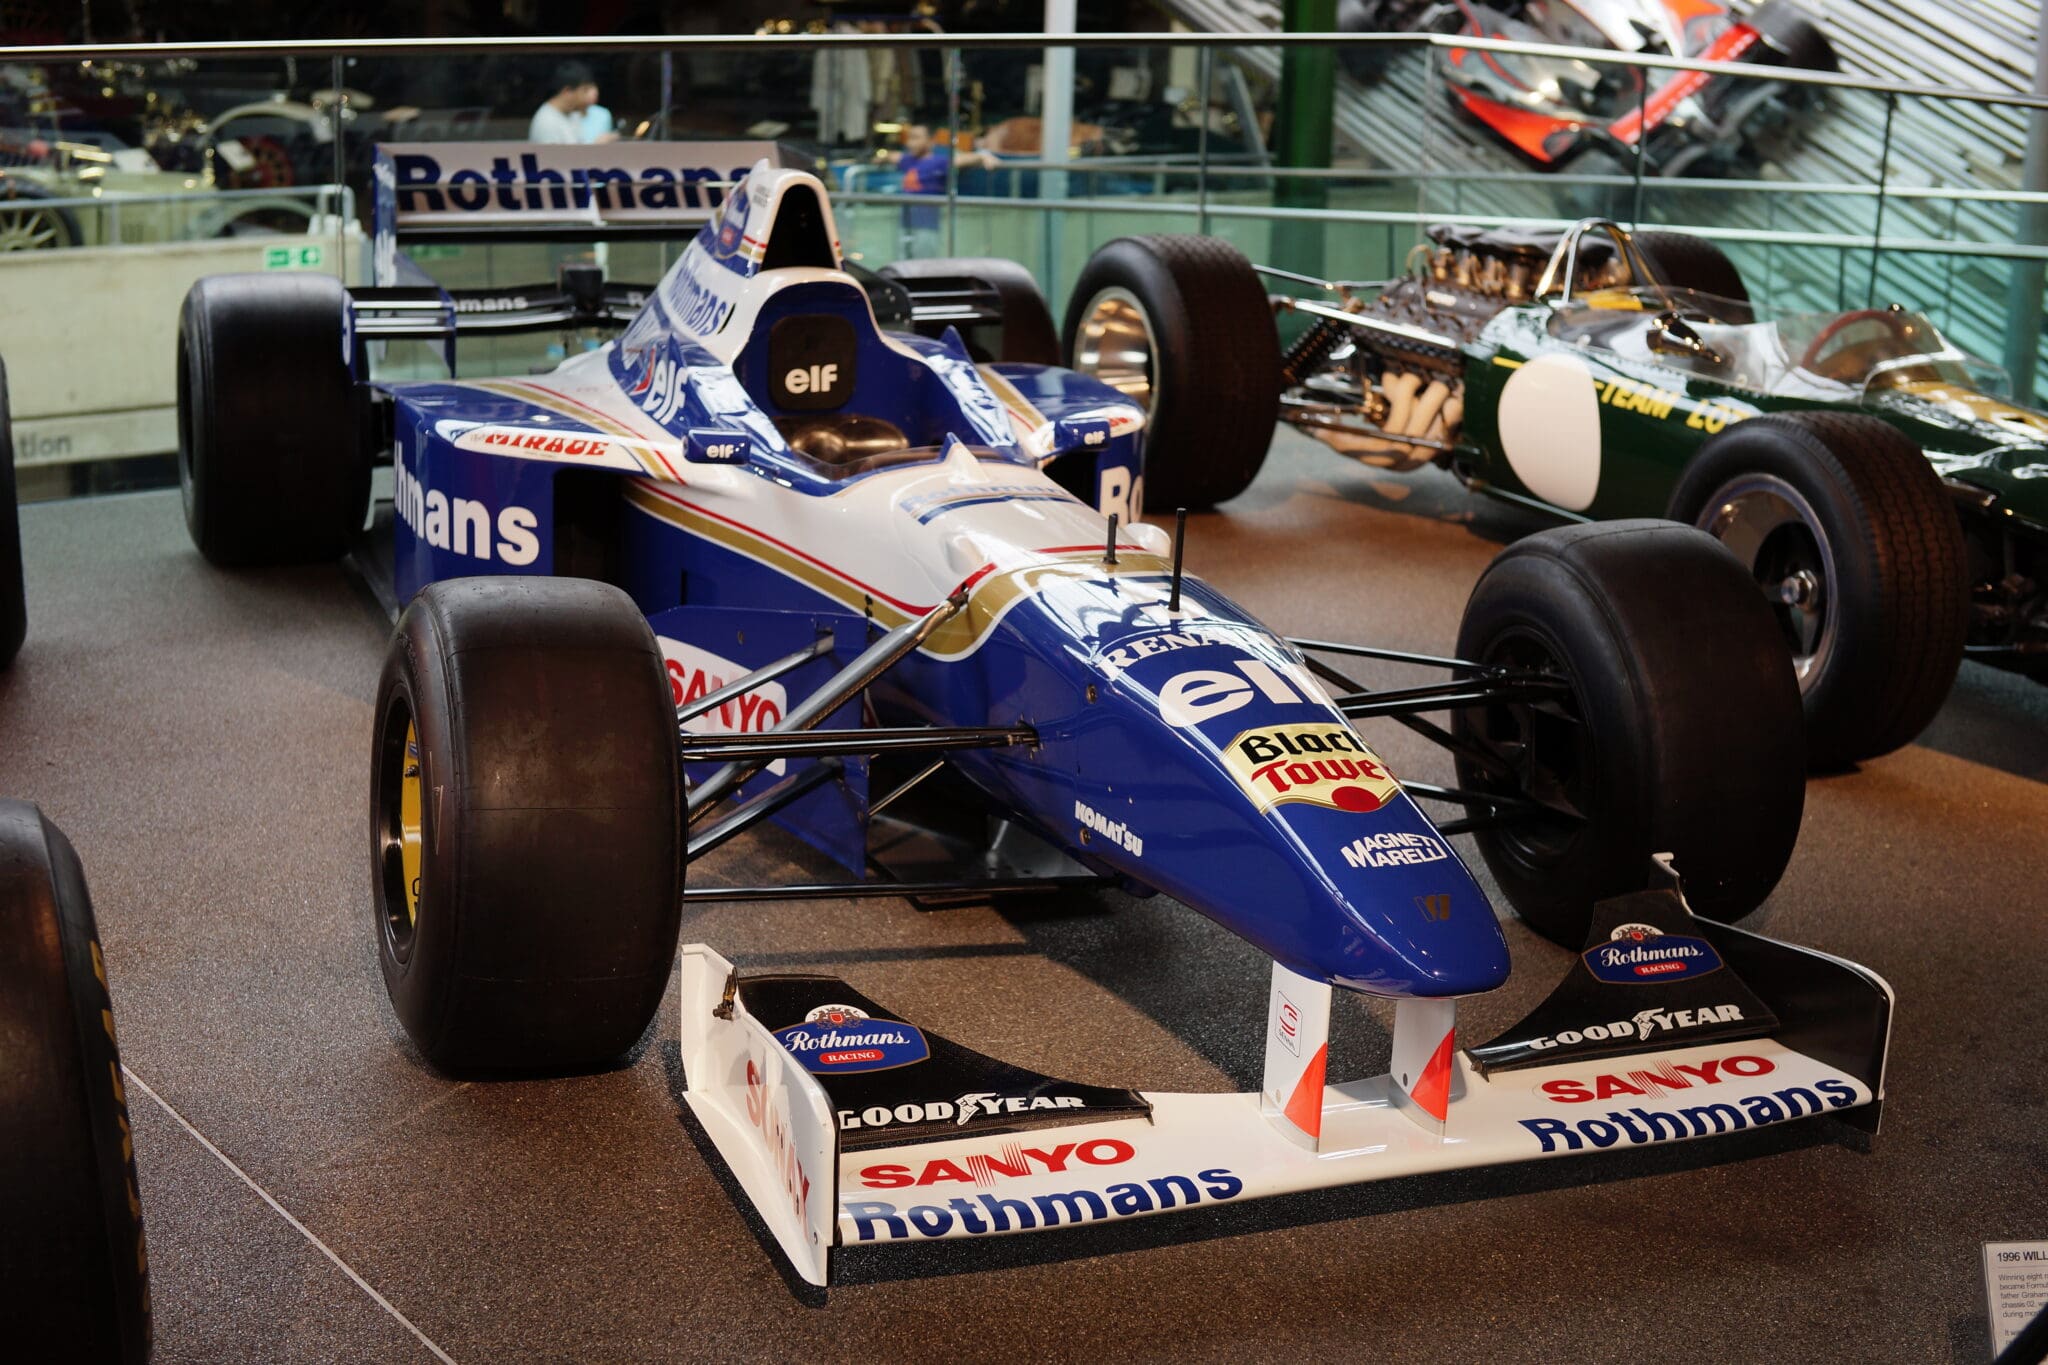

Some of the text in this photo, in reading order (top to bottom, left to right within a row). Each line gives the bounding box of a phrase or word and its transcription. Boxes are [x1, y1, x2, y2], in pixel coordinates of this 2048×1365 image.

[785, 363, 838, 394] elf
[1601, 376, 1682, 420] TEAM
[485, 433, 609, 456] MIRAGE
[706, 444, 734, 459] elf
[1251, 759, 1398, 793] Towe
[1600, 943, 1704, 967] Rothmans
[1640, 962, 1681, 974] RACING
[784, 1030, 910, 1051] Rothmans
[827, 1051, 876, 1062] RACING
[1540, 1054, 1776, 1103] SANYO
[1517, 1078, 1858, 1153] Rothmans
[860, 1138, 1136, 1188] SANYO
[841, 1168, 1243, 1241] Rothmans
[1997, 1252, 2021, 1262] 1996
